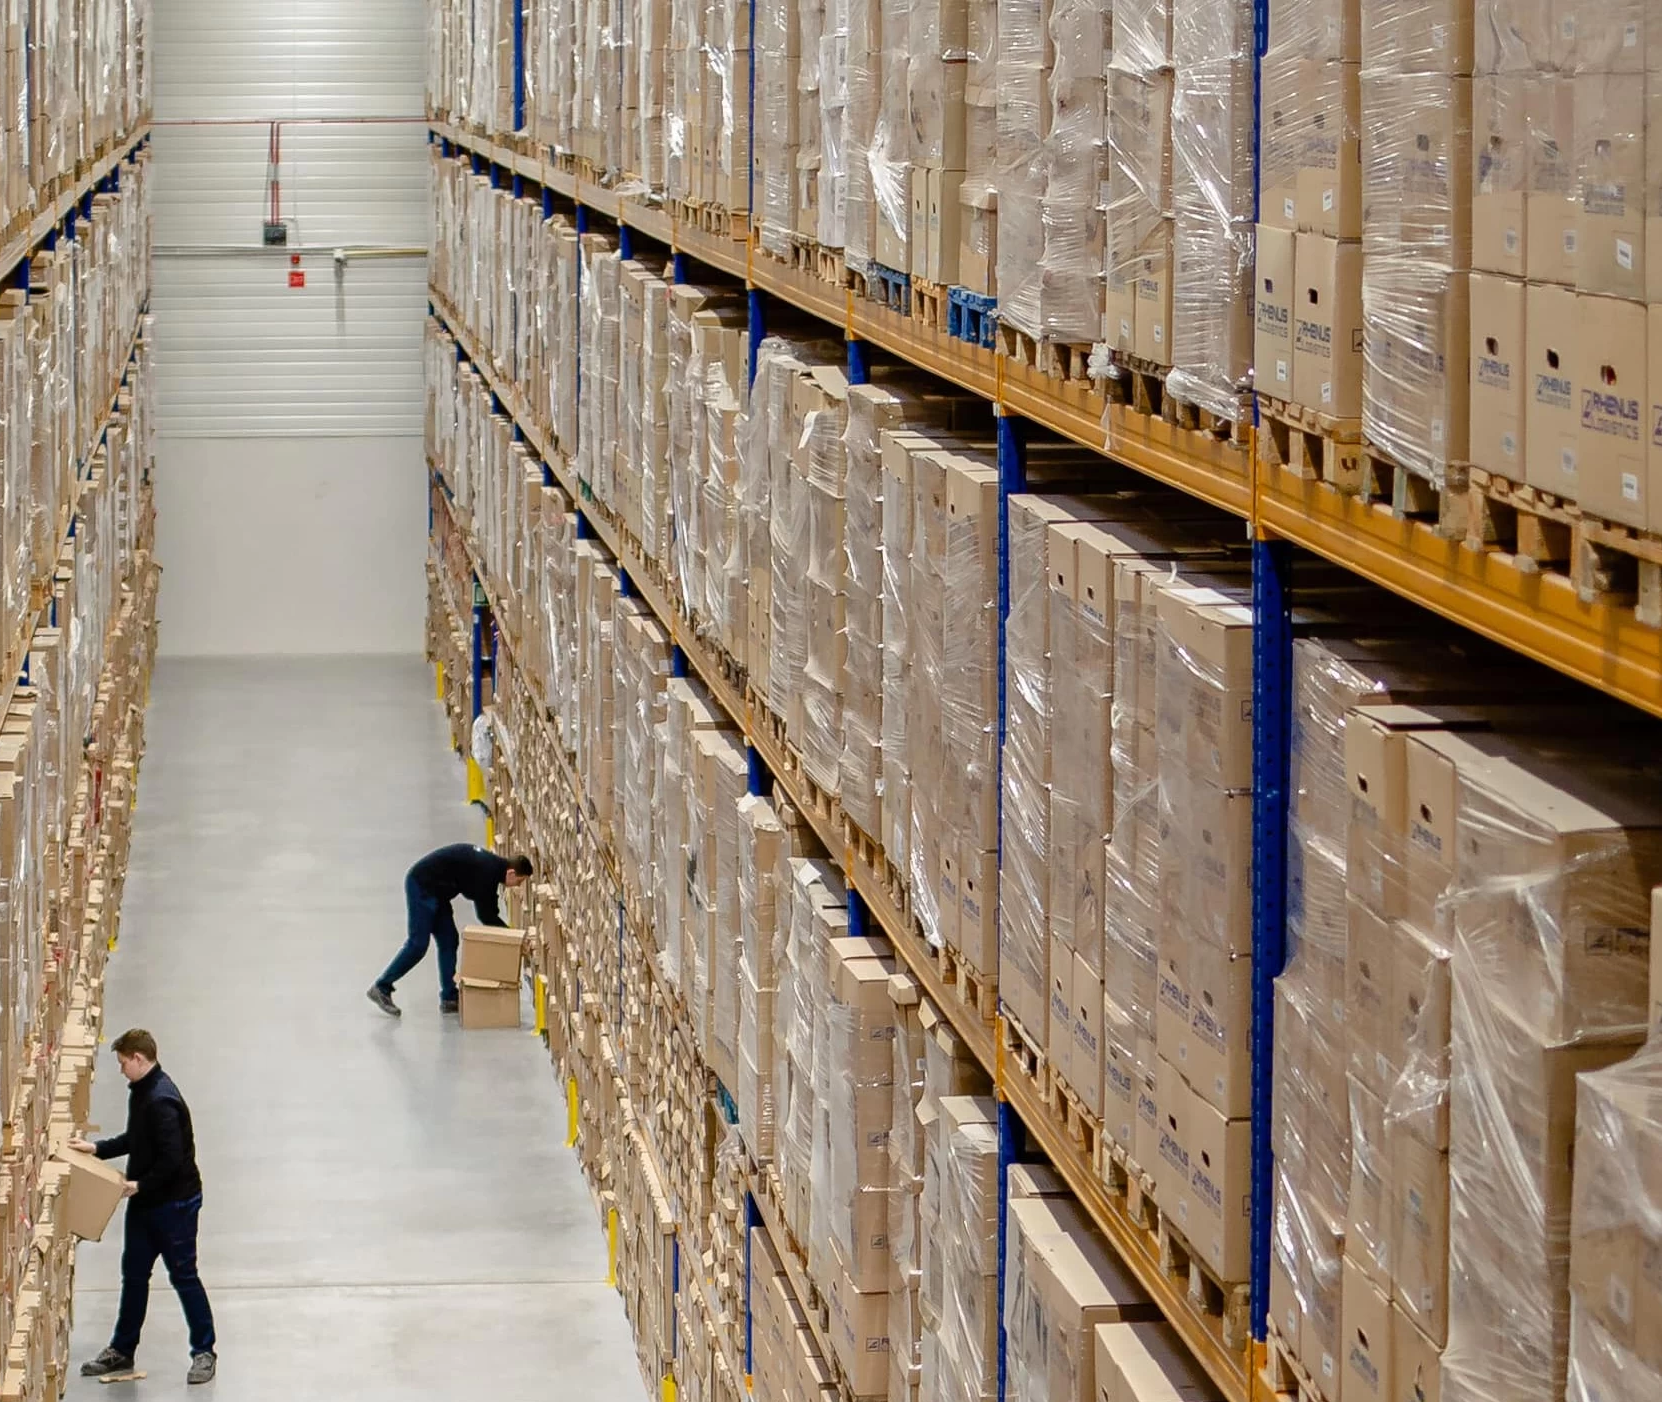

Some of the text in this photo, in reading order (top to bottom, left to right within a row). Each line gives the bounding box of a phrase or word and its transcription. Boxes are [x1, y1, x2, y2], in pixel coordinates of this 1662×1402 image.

[1262, 303, 1288, 323] RHENUS
[1303, 321, 1331, 342] RHENUS
[1543, 376, 1571, 395] RHENUS
[1593, 392, 1639, 421] RHENUS
